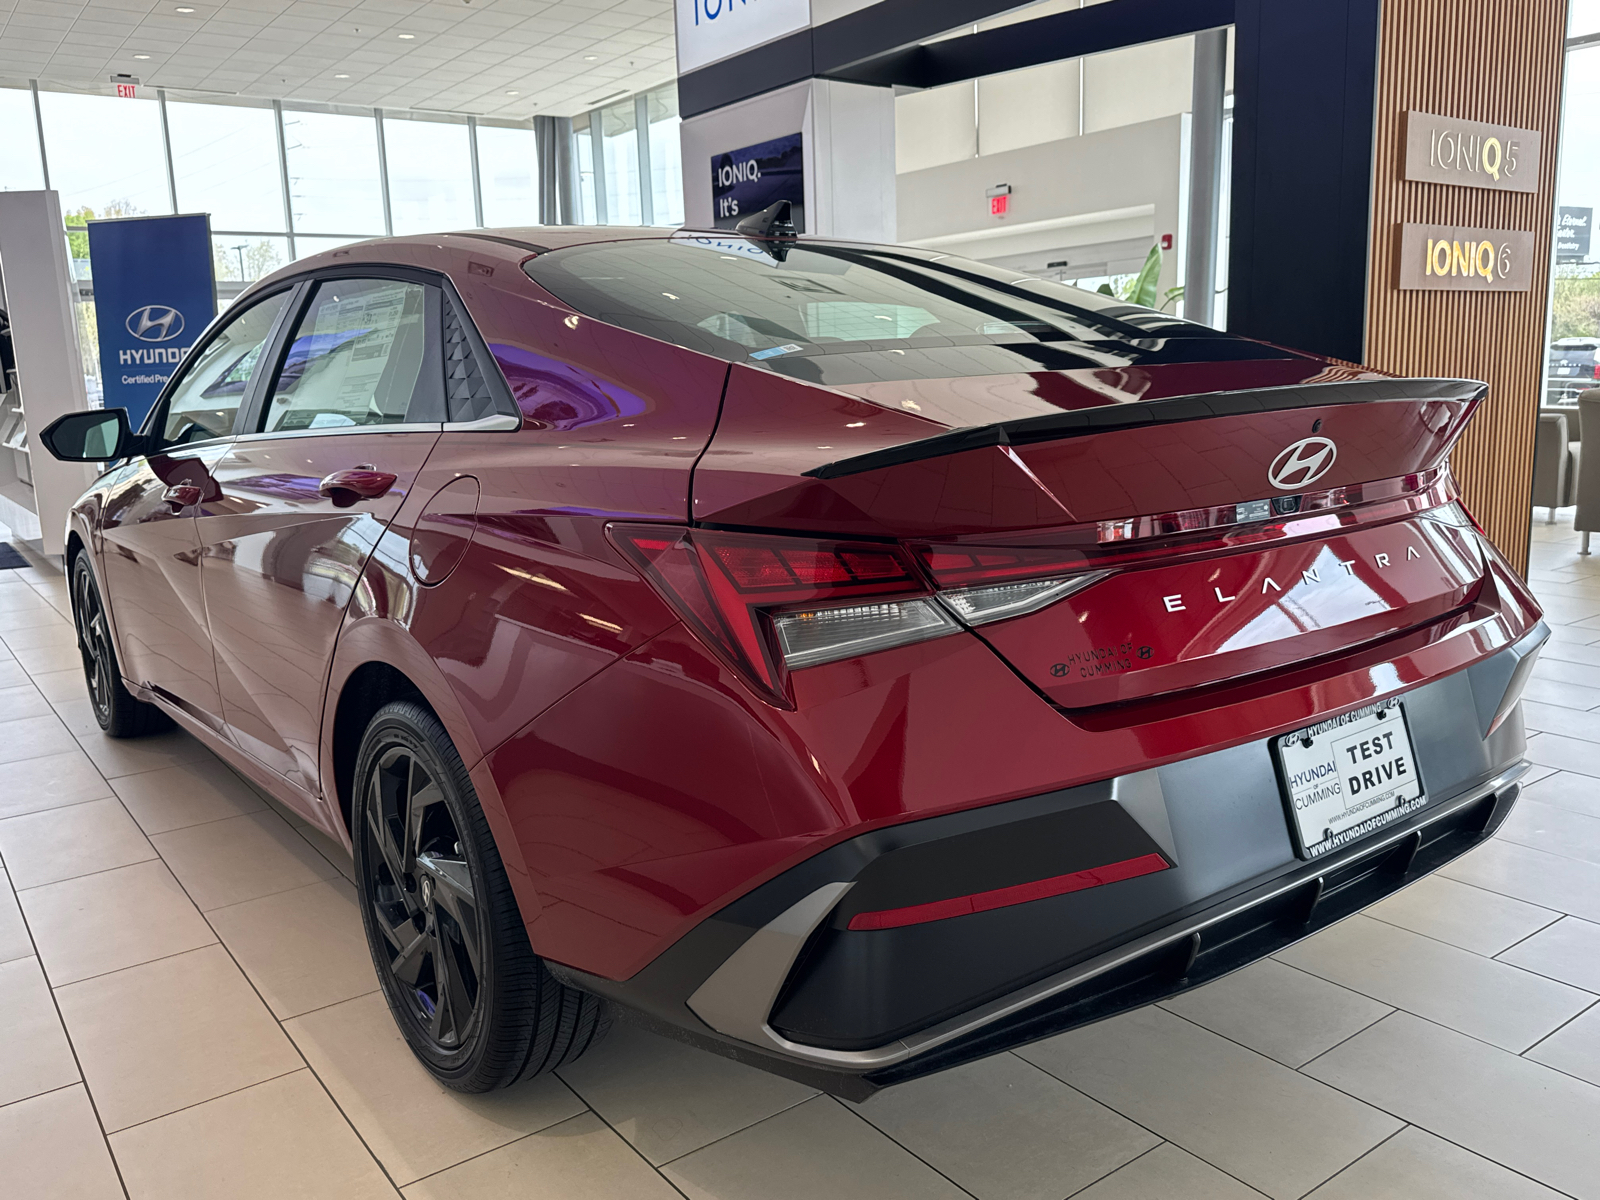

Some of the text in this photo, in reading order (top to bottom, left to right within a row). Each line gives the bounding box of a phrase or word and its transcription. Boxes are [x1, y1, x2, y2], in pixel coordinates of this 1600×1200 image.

[117, 84, 136, 98] EXIT
[1430, 128, 1520, 182] IONIQ 5
[718, 159, 762, 187] IONIQ.
[720, 197, 739, 218] It's
[991, 196, 1007, 215] EXIT
[1425, 238, 1514, 284] IONIQ 6
[121, 374, 155, 385] Certified
[1162, 545, 1421, 613] ELANTRA
[1067, 642, 1133, 665] HYUNDAI OF
[1080, 658, 1133, 678] CUMMING
[1307, 702, 1382, 738] HYUNDAI OF CUMMING
[1346, 731, 1394, 765] TEST
[1290, 760, 1337, 789] HYUNDAI
[1348, 756, 1407, 796] DRIVE
[1294, 783, 1341, 811] CUMMING
[1310, 795, 1427, 858] WWW.HYUNDAIOFCUMMING.COM
